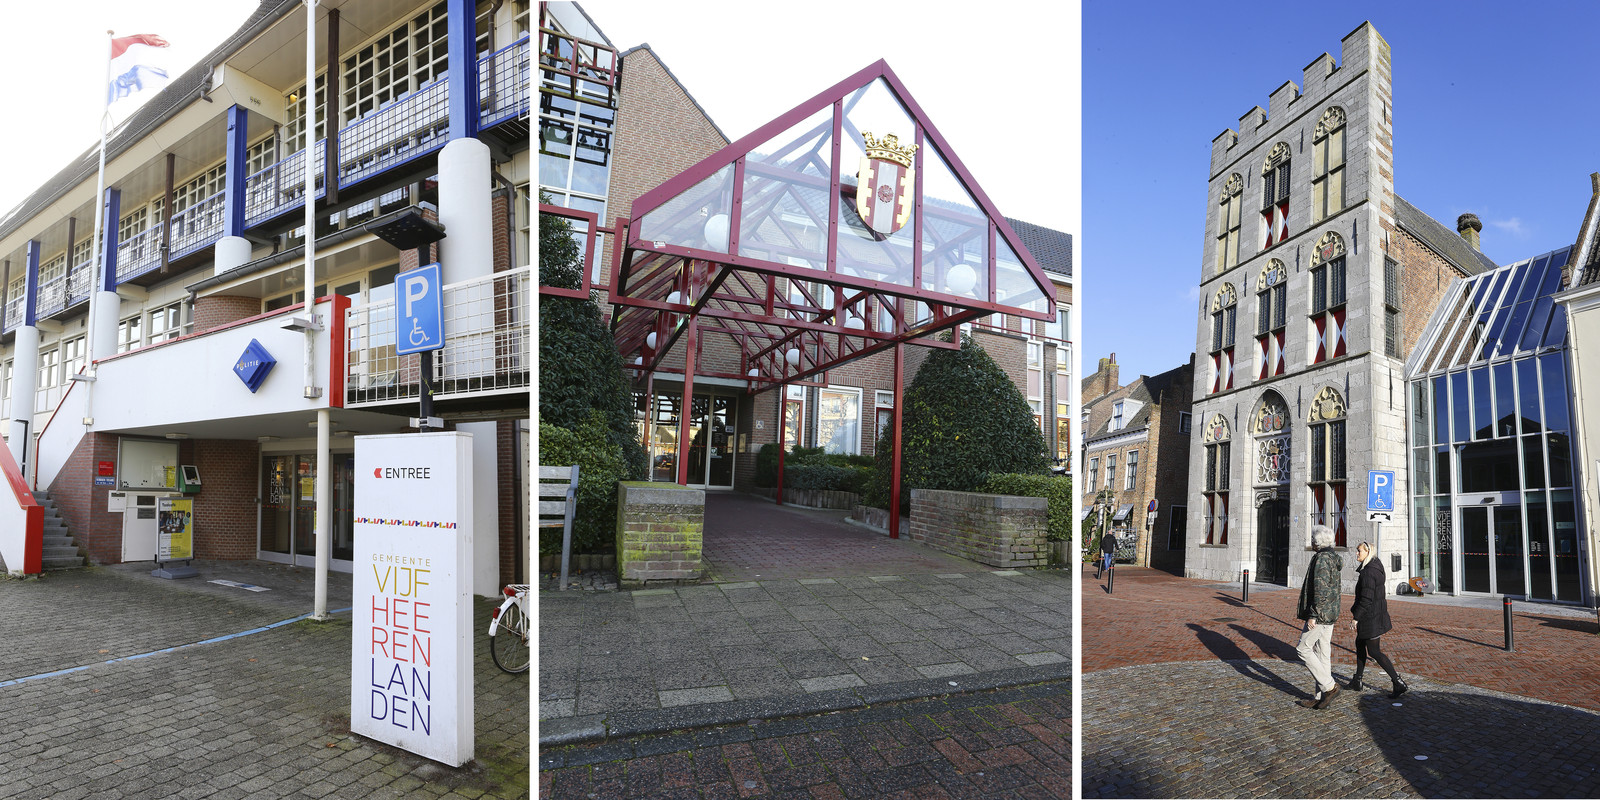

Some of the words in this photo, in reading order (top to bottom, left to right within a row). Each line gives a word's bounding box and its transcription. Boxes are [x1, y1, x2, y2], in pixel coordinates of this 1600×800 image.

[405, 276, 429, 318] P
[236, 360, 259, 371] POLITIE
[385, 467, 431, 479] ENTREE
[1373, 474, 1388, 493] P
[1437, 520, 1451, 528] HEE
[1437, 527, 1452, 535] REN
[372, 553, 431, 567] GEMEENTE
[373, 564, 431, 598] VIJF
[372, 595, 431, 634] HEE
[372, 626, 431, 668] REN
[371, 657, 431, 701] LAN
[371, 689, 431, 736] DEN
